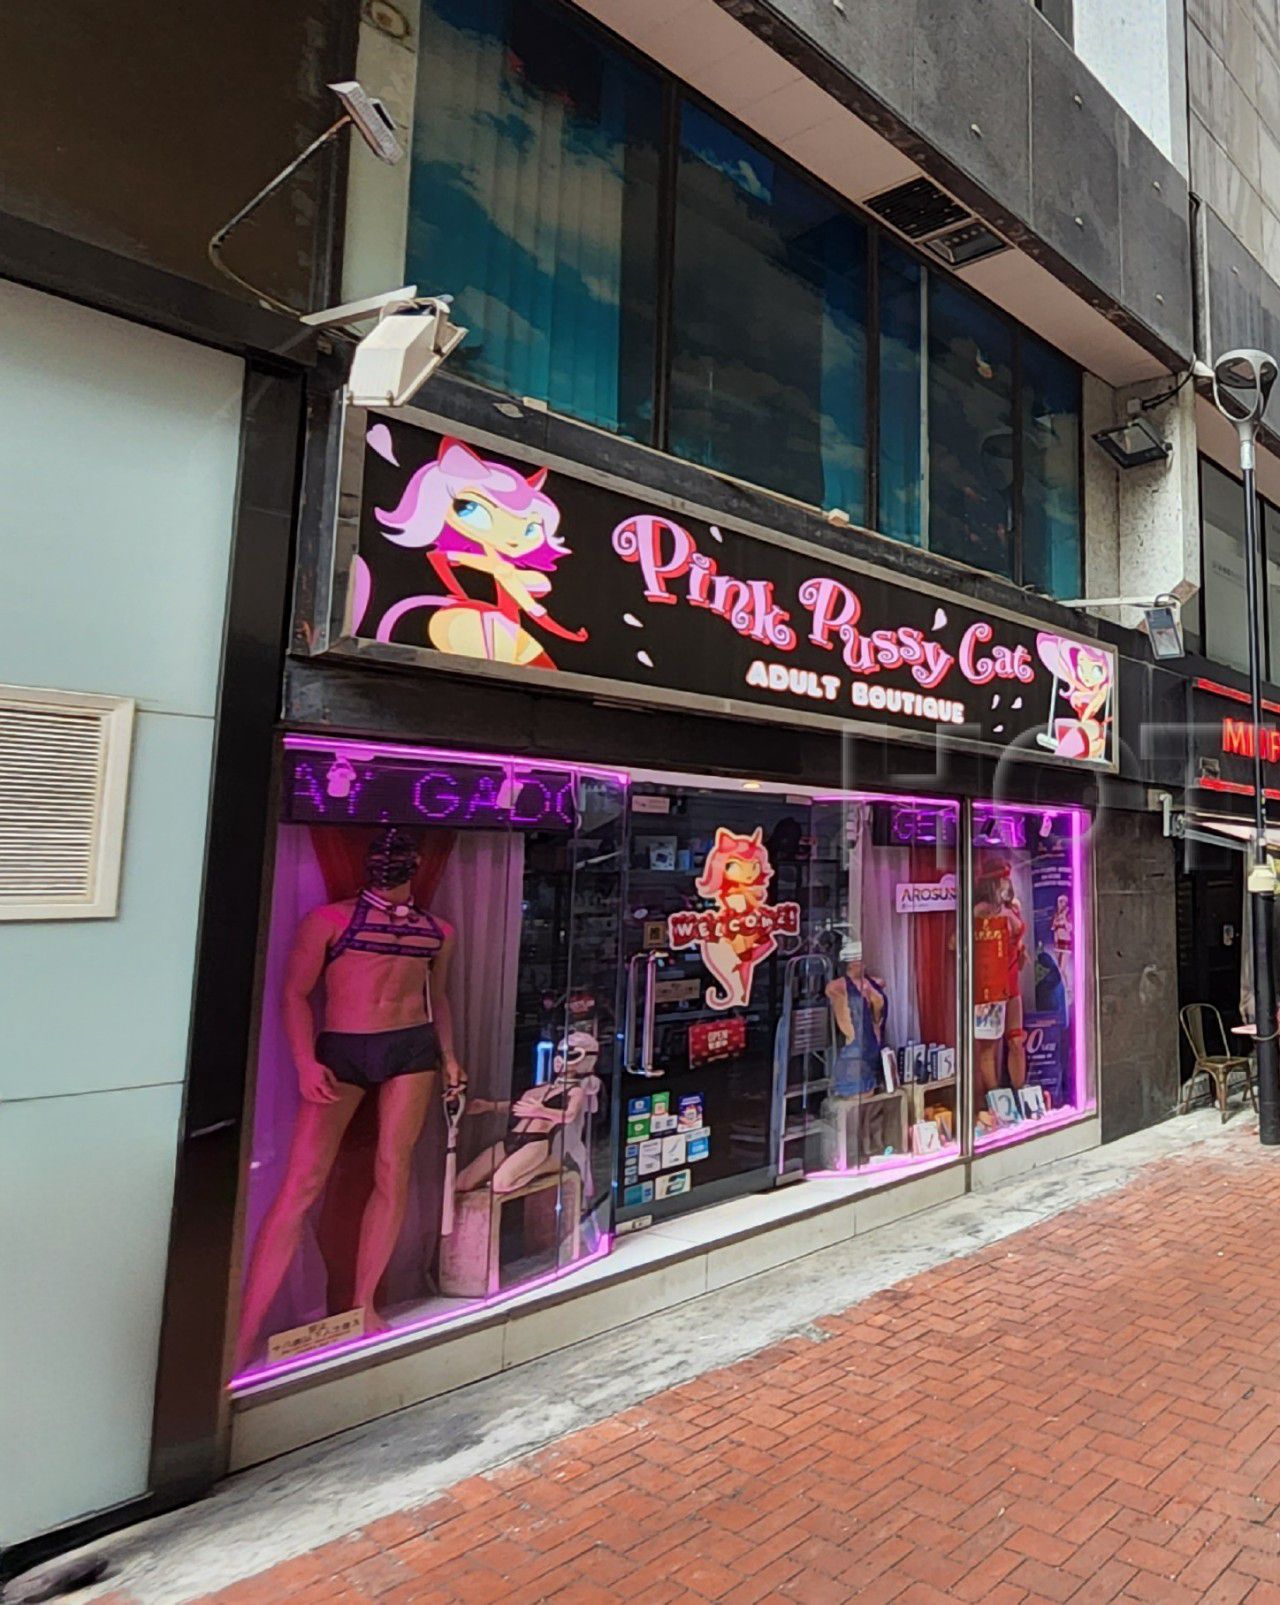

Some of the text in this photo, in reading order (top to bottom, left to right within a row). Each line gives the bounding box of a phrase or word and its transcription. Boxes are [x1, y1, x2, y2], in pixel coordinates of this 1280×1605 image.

[611, 514, 1035, 688] Pink Pussy Cat
[745, 660, 966, 725] ADULT BOUTIQUE
